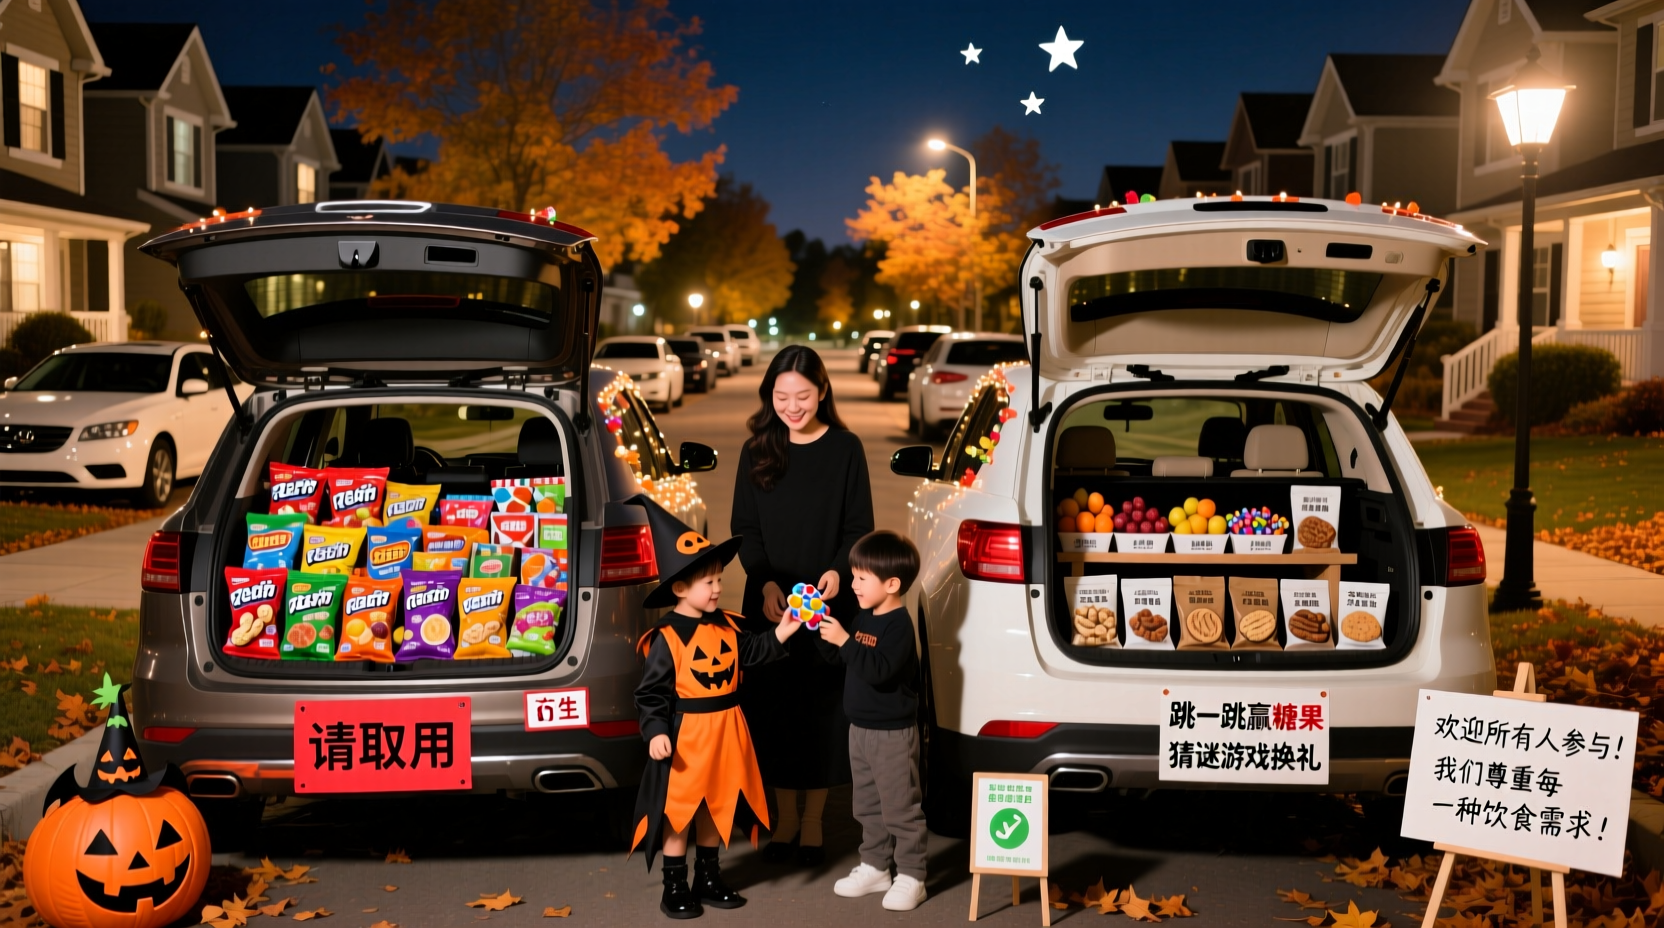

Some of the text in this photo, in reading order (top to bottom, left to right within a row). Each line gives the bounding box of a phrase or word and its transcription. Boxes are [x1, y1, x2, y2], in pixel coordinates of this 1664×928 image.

[1169, 701, 1324, 731] 跳一跳赢糖果
[308, 721, 454, 771] 请取用
[1169, 740, 1322, 771] 猜谜游戏换礼
[1433, 755, 1563, 797] 我们尊重每
